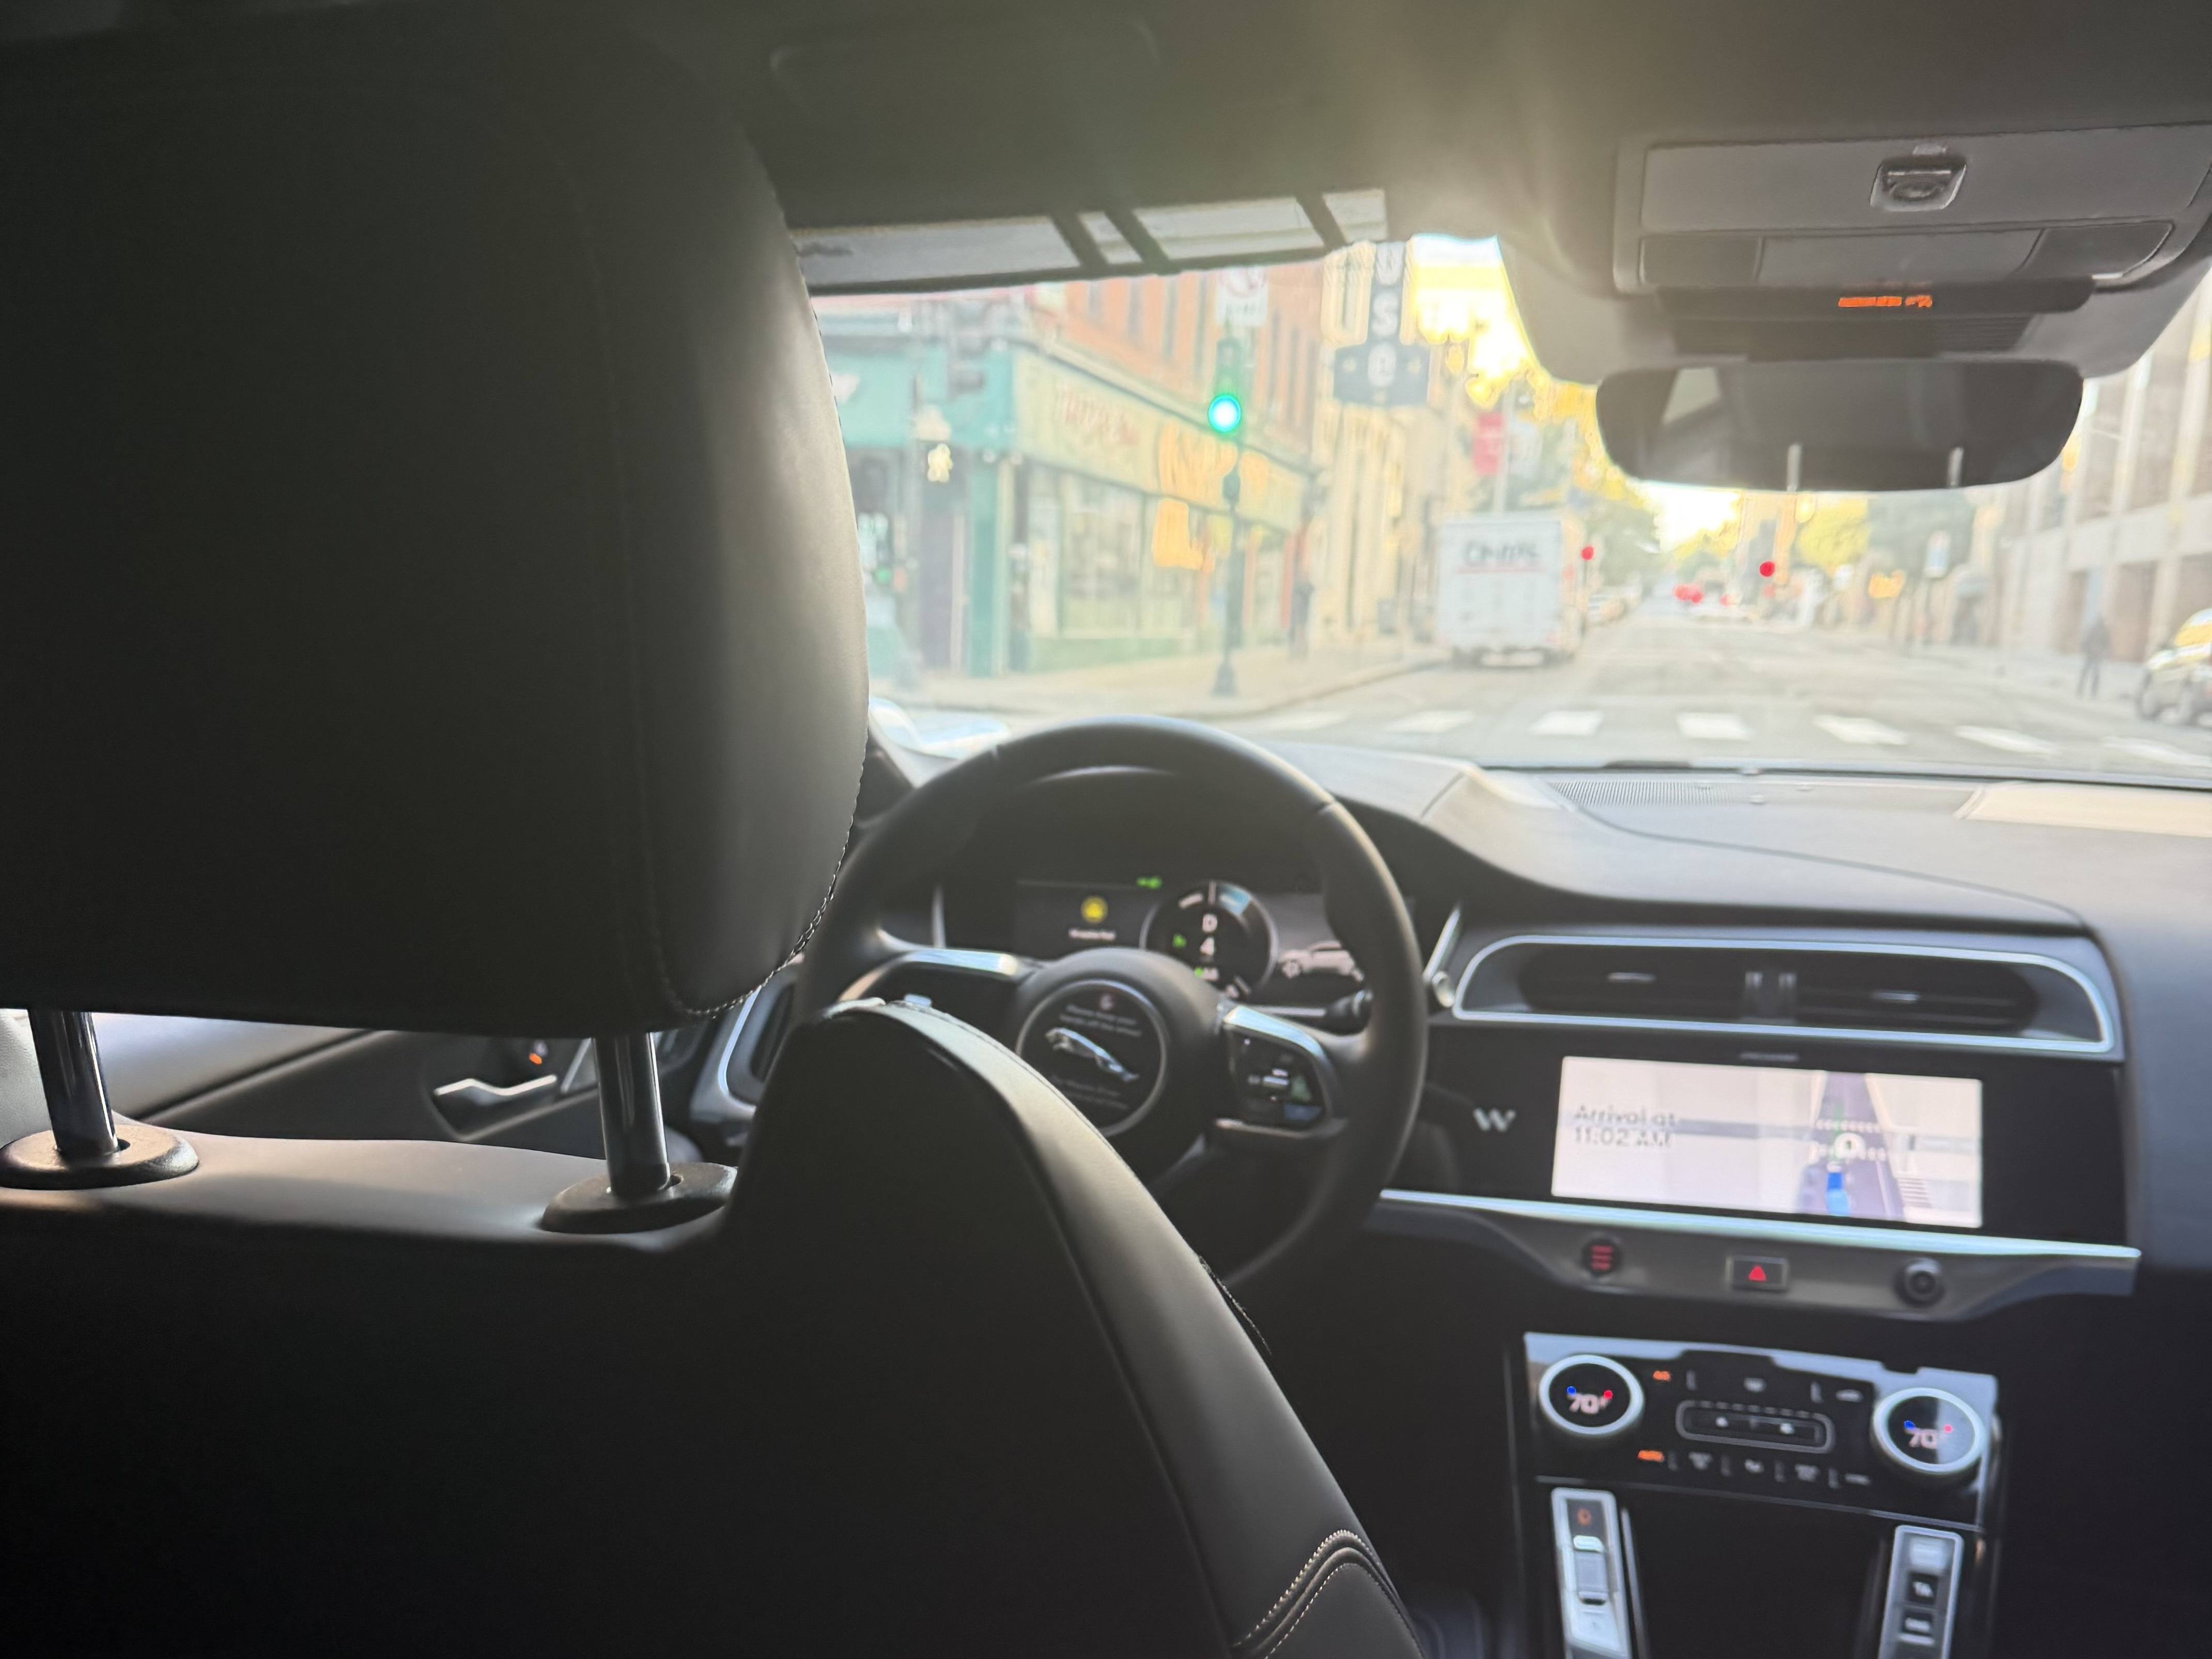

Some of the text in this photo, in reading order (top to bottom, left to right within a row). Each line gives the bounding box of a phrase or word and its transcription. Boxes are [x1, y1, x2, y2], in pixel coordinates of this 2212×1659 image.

[1573, 1105, 1676, 1128] Arrival at
[1575, 1126, 1672, 1147] 11:02 AM
